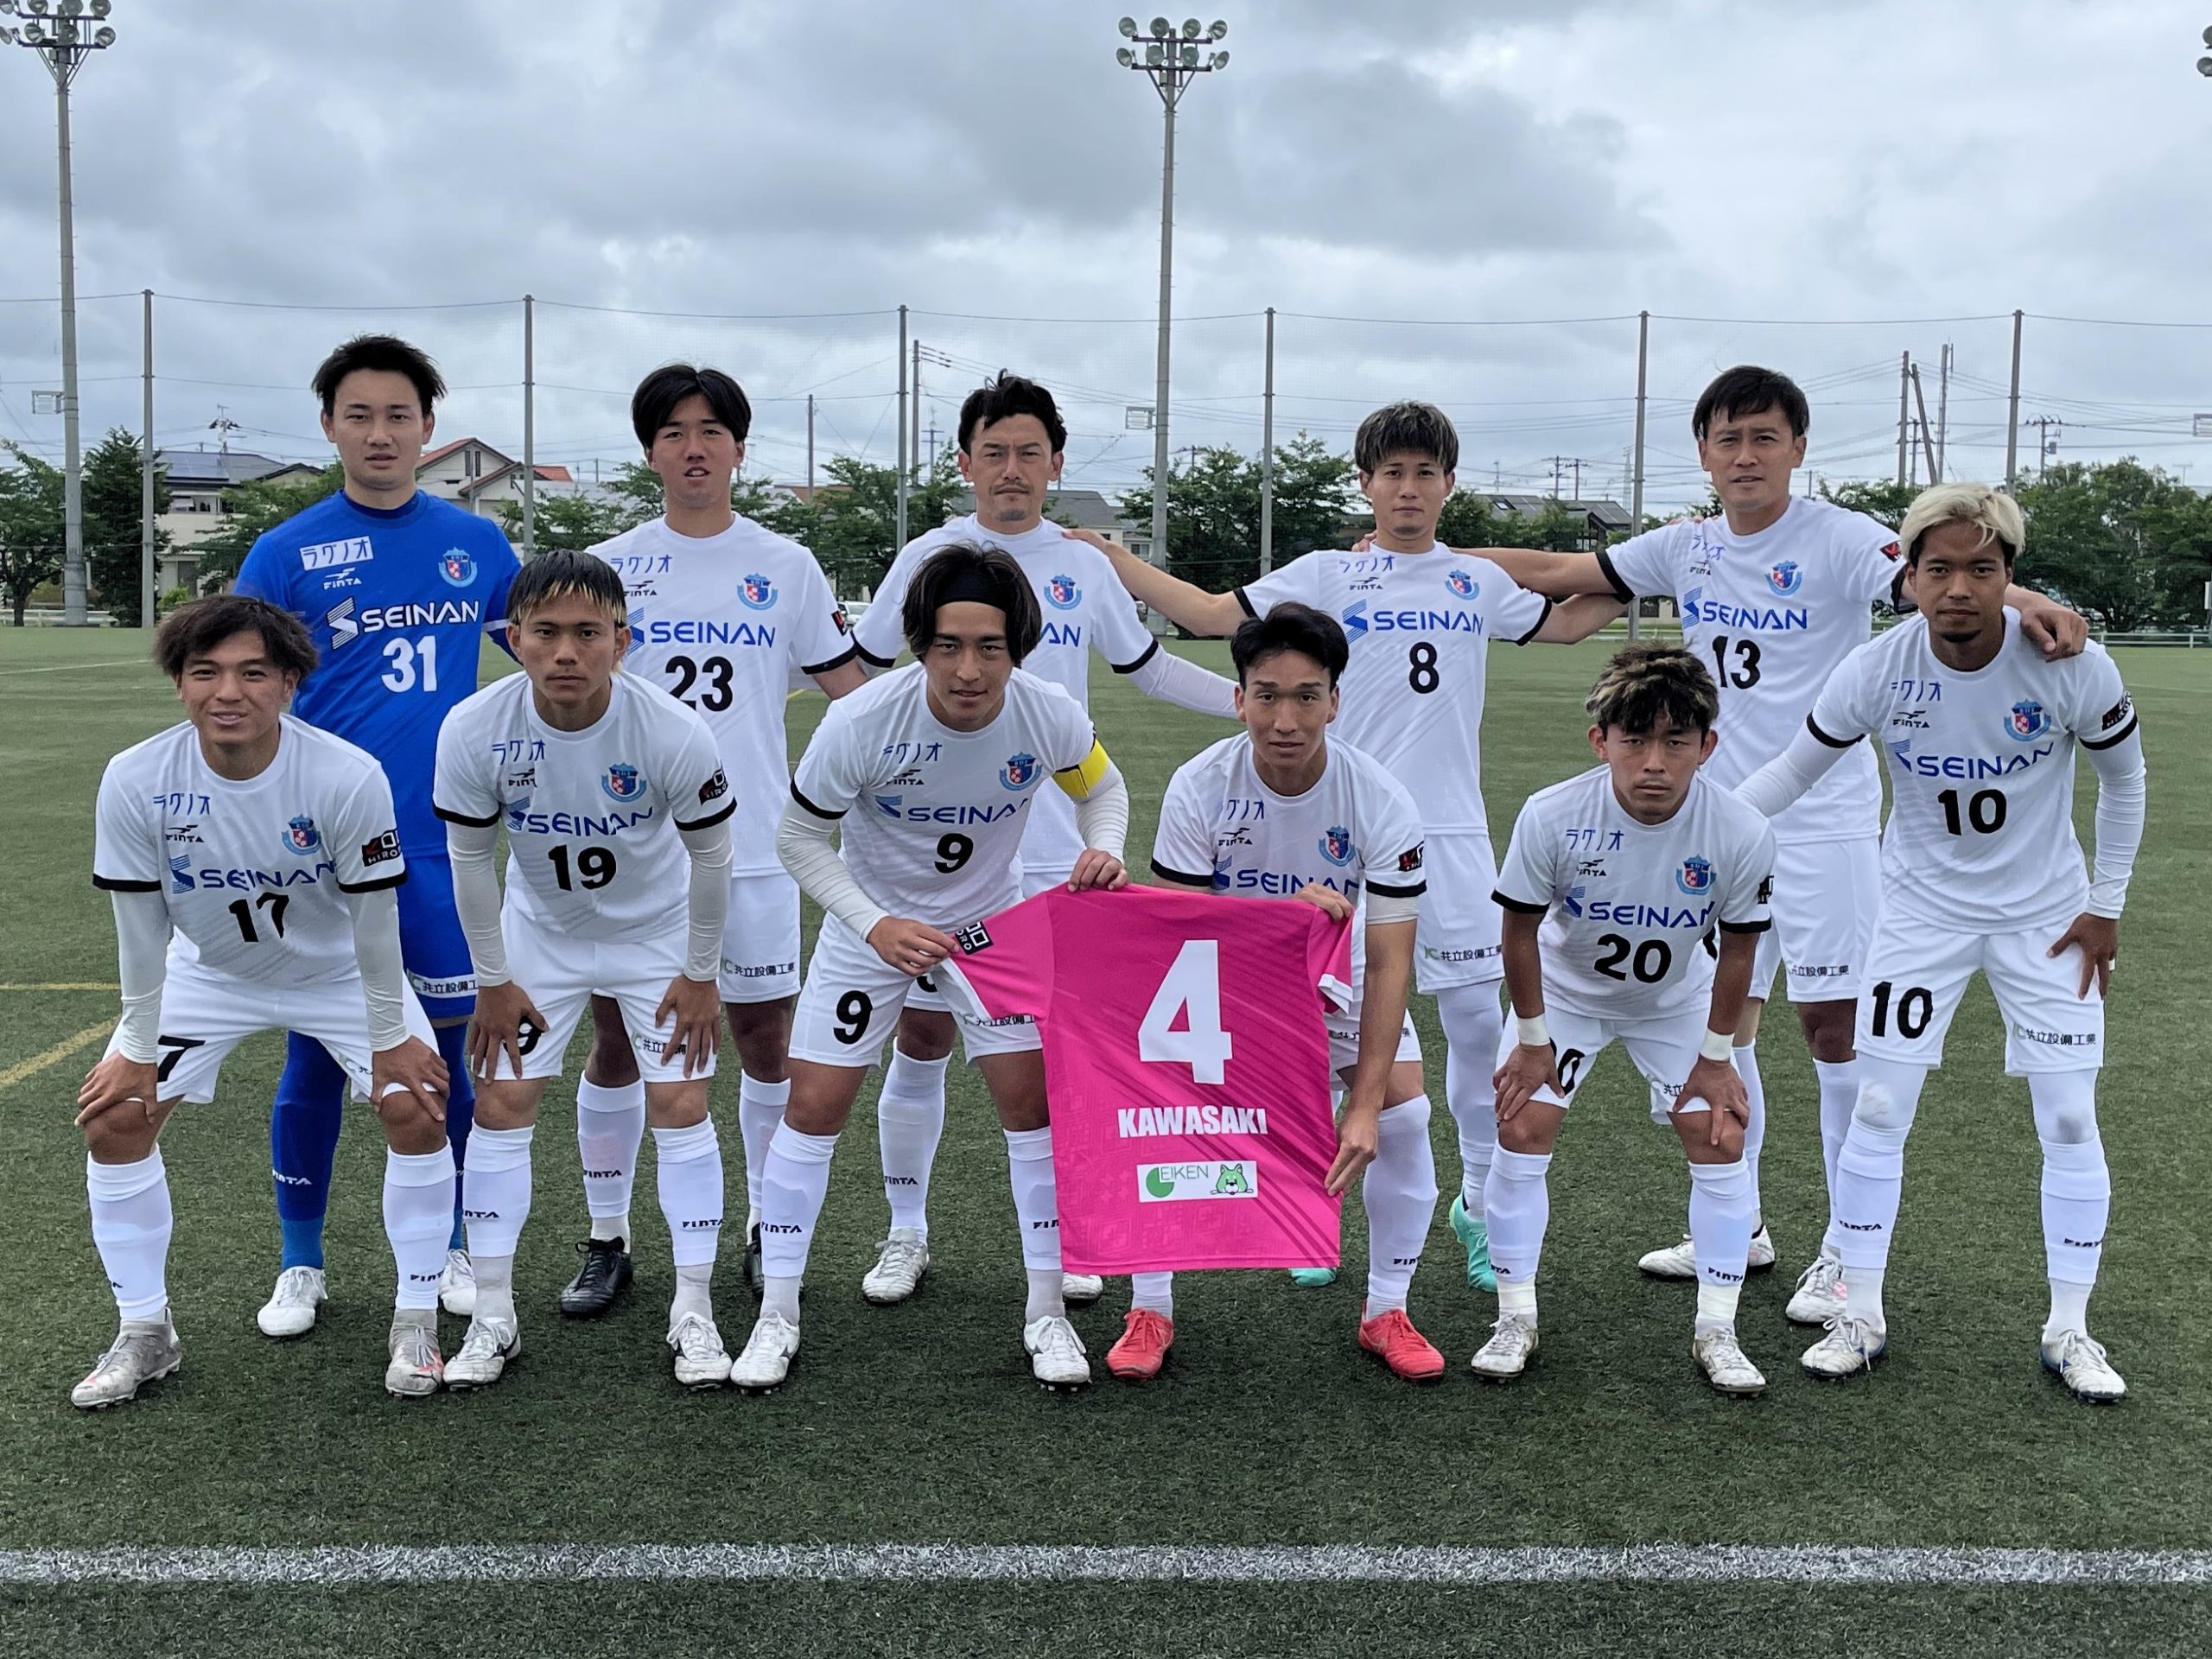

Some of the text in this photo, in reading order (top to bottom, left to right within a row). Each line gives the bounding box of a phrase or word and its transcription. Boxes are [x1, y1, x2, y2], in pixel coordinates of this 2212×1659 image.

[302, 539, 369, 567] ラグノオ
[361, 601, 479, 632] SEINAN
[1373, 610, 1484, 636] SEINAN
[1702, 601, 1808, 630] SEINAN
[650, 621, 776, 648] SEINAN
[381, 635, 437, 692] 31
[1408, 641, 1440, 694] 8
[1712, 635, 1761, 690] 13
[665, 655, 734, 712] 23
[1916, 741, 2054, 779] SEINAN
[508, 779, 537, 788] FINT
[527, 805, 652, 836] SEINAN
[1227, 800, 1265, 821] グノオ
[1937, 788, 2007, 836] 10
[934, 833, 974, 874] 9
[1566, 829, 1625, 852] ラグノオ
[200, 861, 336, 892] SEINAN
[548, 843, 617, 892] 19
[1576, 865, 1607, 877] INTA
[228, 891, 289, 943] 17
[1593, 933, 1673, 984] 20
[423, 980, 479, 995] 共立設備工
[833, 989, 874, 1046] 9
[1137, 939, 1233, 1085] 4
[1872, 981, 1934, 1039] 10
[1117, 1104, 1268, 1139] KAWASAKI
[464, 1210, 499, 1219] NTA
[1033, 1218, 1059, 1230] FIN
[410, 1267, 447, 1282] FINT
[1393, 1257, 1421, 1266] FIN
